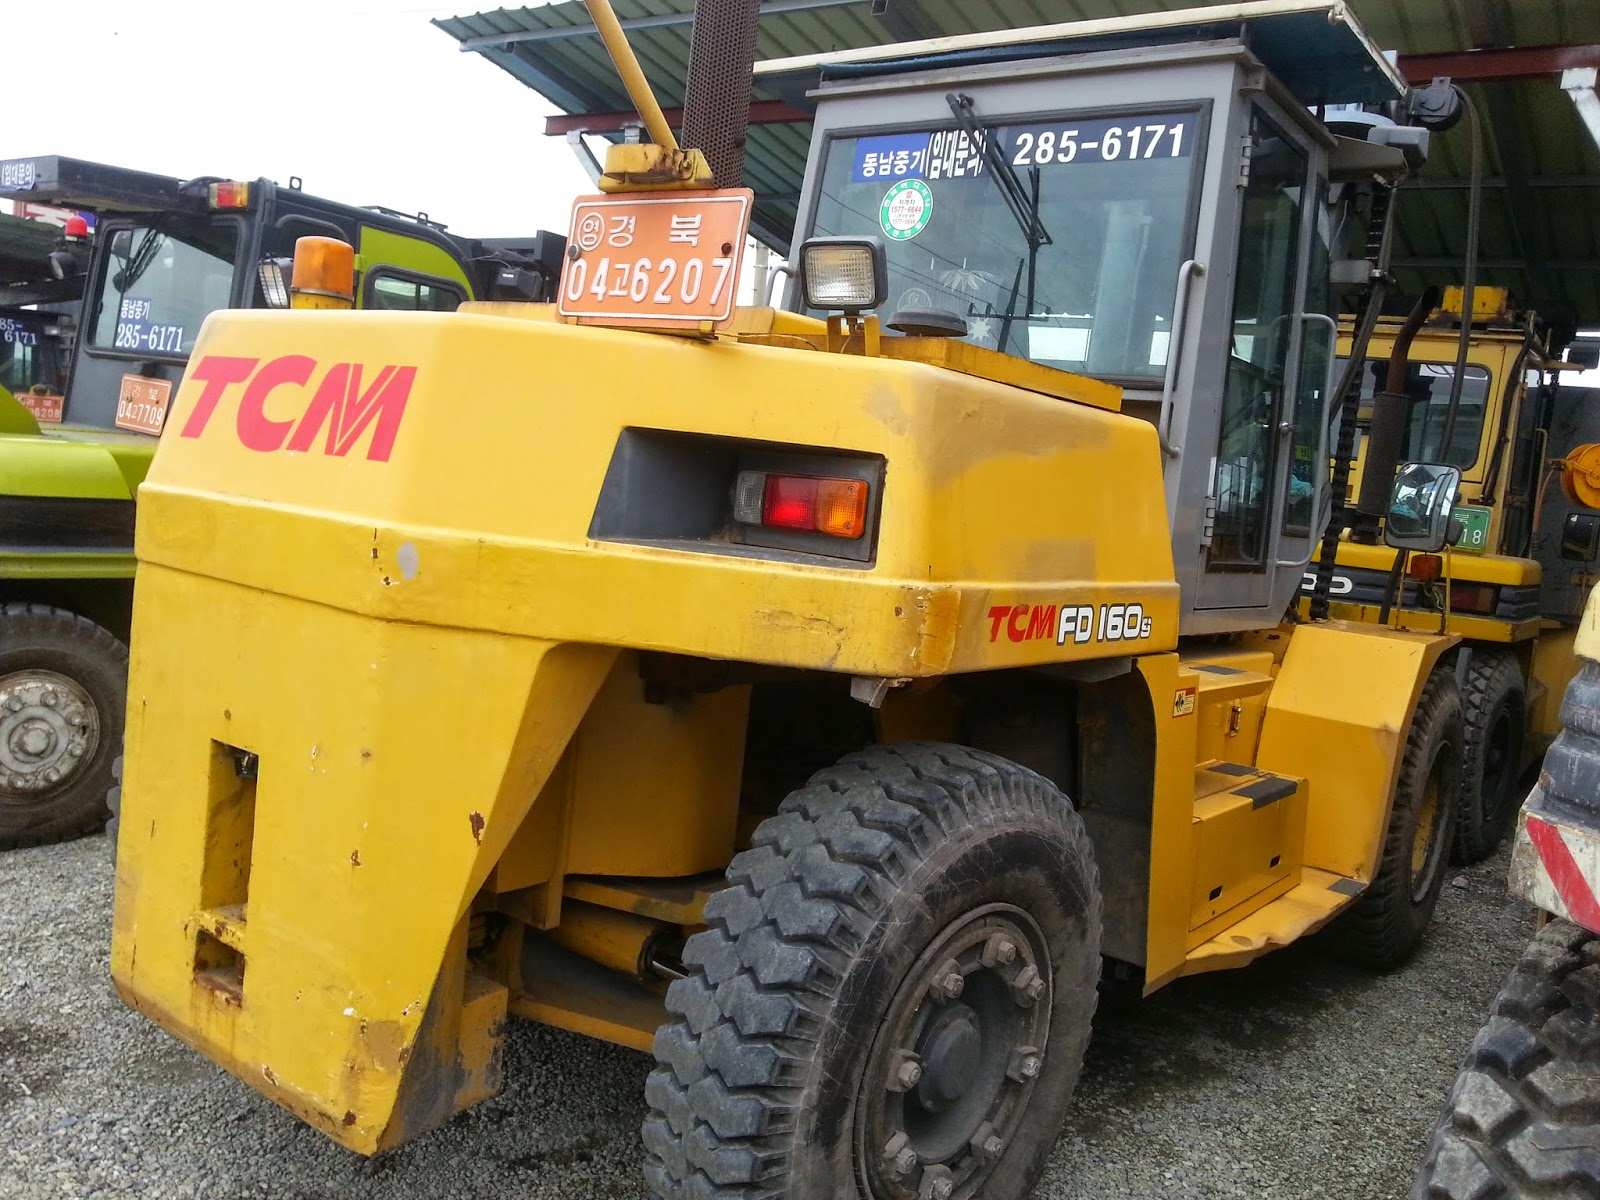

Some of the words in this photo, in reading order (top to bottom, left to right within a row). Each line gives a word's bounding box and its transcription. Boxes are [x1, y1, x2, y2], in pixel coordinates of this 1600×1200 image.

[863, 148, 926, 177] 동남중기
[1013, 123, 1185, 167] 285-6171
[567, 256, 732, 305] 04고6207
[120, 299, 151, 321] 동남중기
[4, 330, 38, 346] 6171
[115, 323, 184, 352] 285-6171
[180, 354, 418, 463] TCM
[987, 604, 1056, 643] TCM
